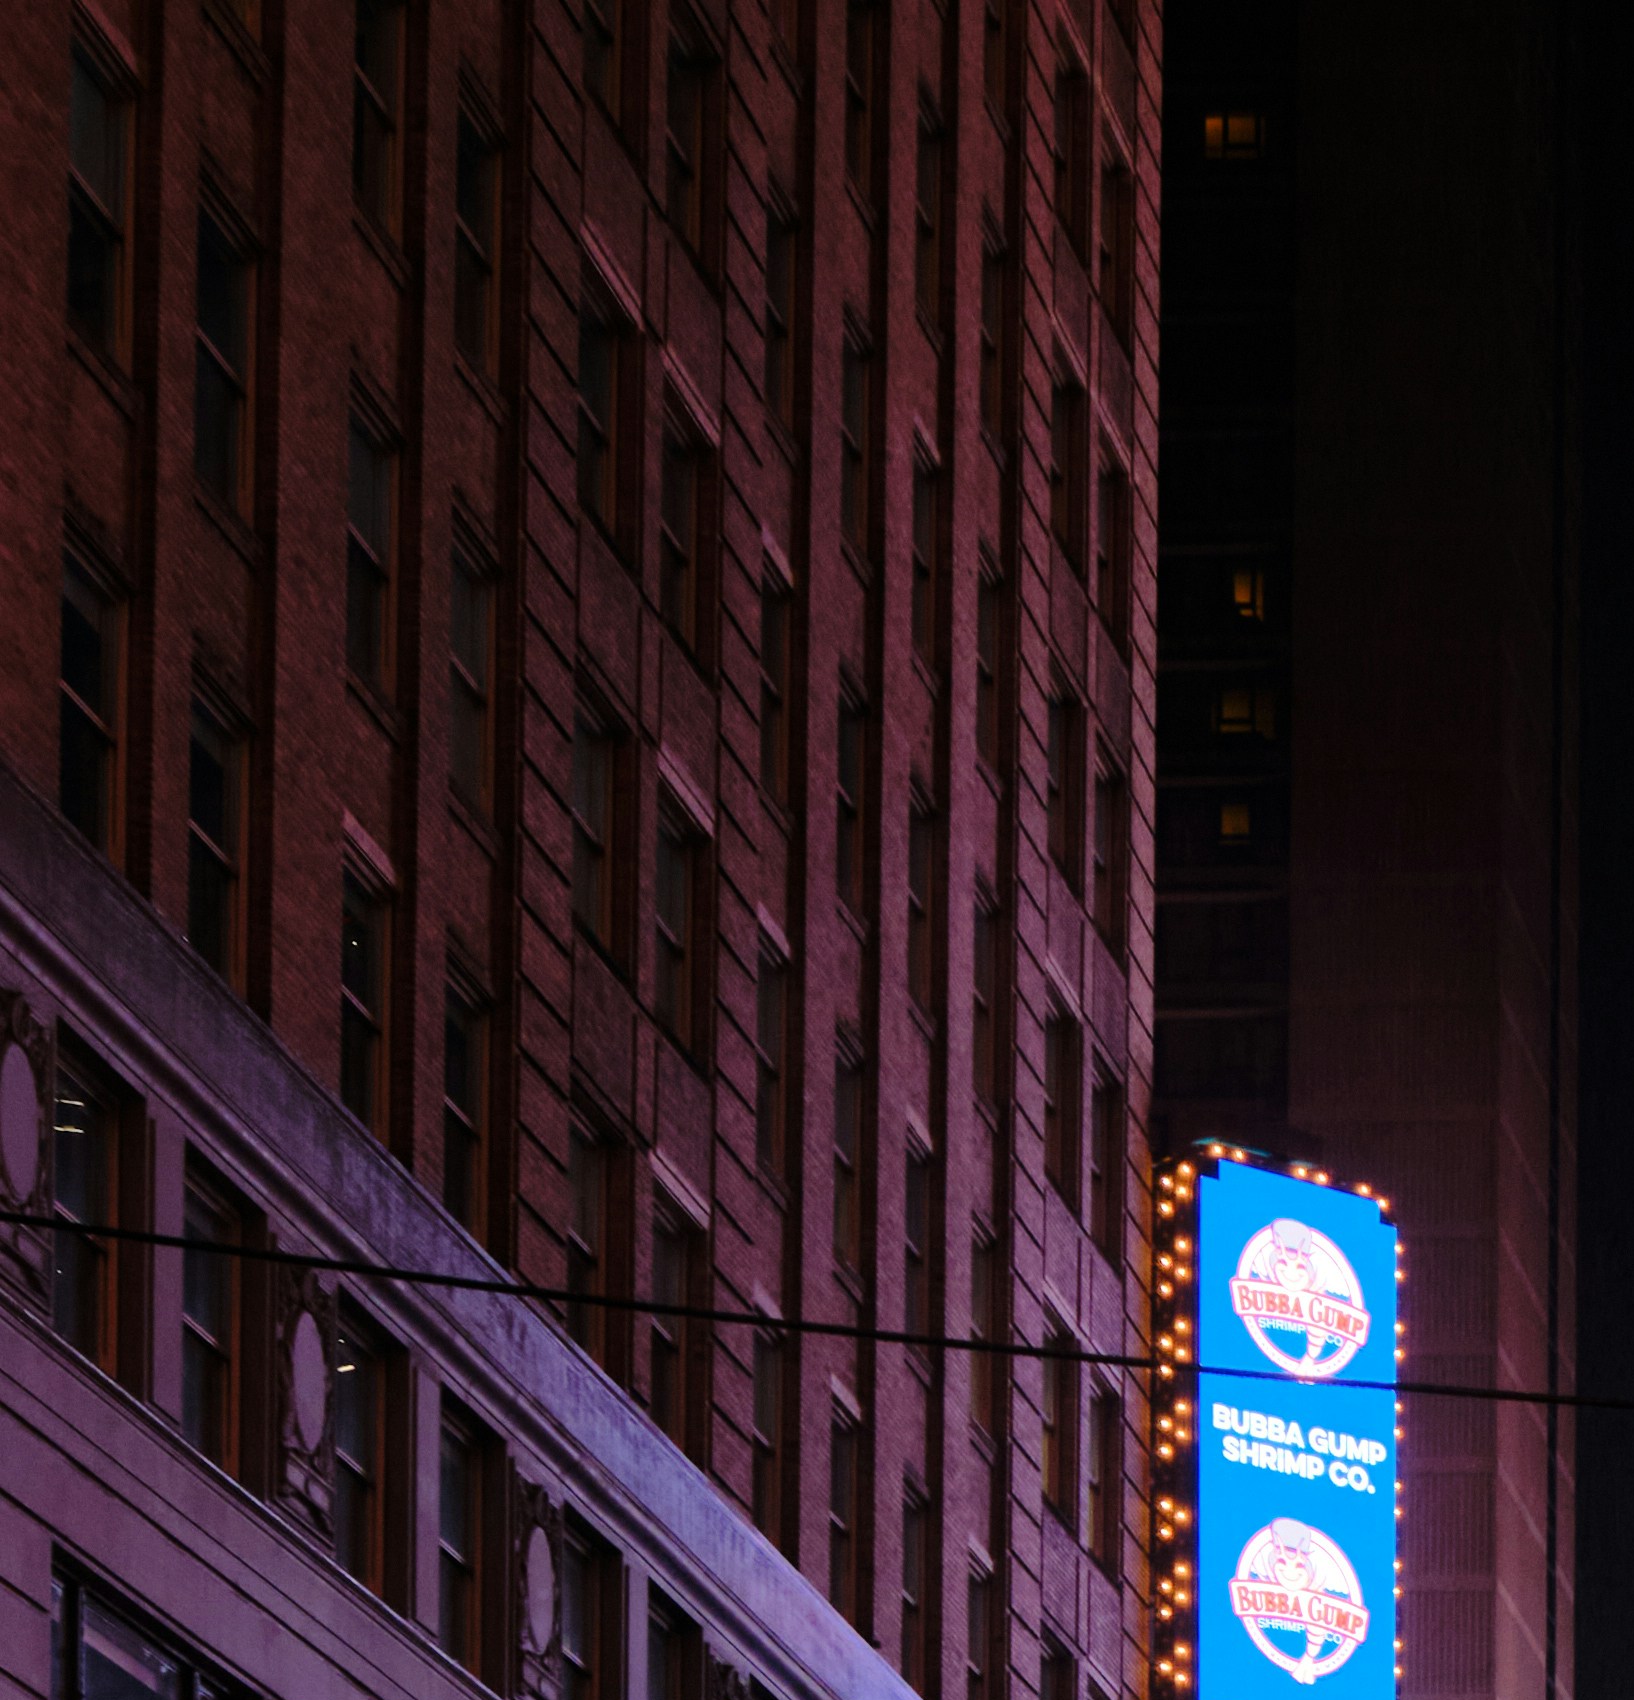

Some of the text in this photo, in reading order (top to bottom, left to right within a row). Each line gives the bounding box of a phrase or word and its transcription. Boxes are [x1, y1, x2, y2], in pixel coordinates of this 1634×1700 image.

[1212, 1403, 1387, 1465] BUBBA GUMP
[1222, 1435, 1376, 1494] SHRIMP CO.
